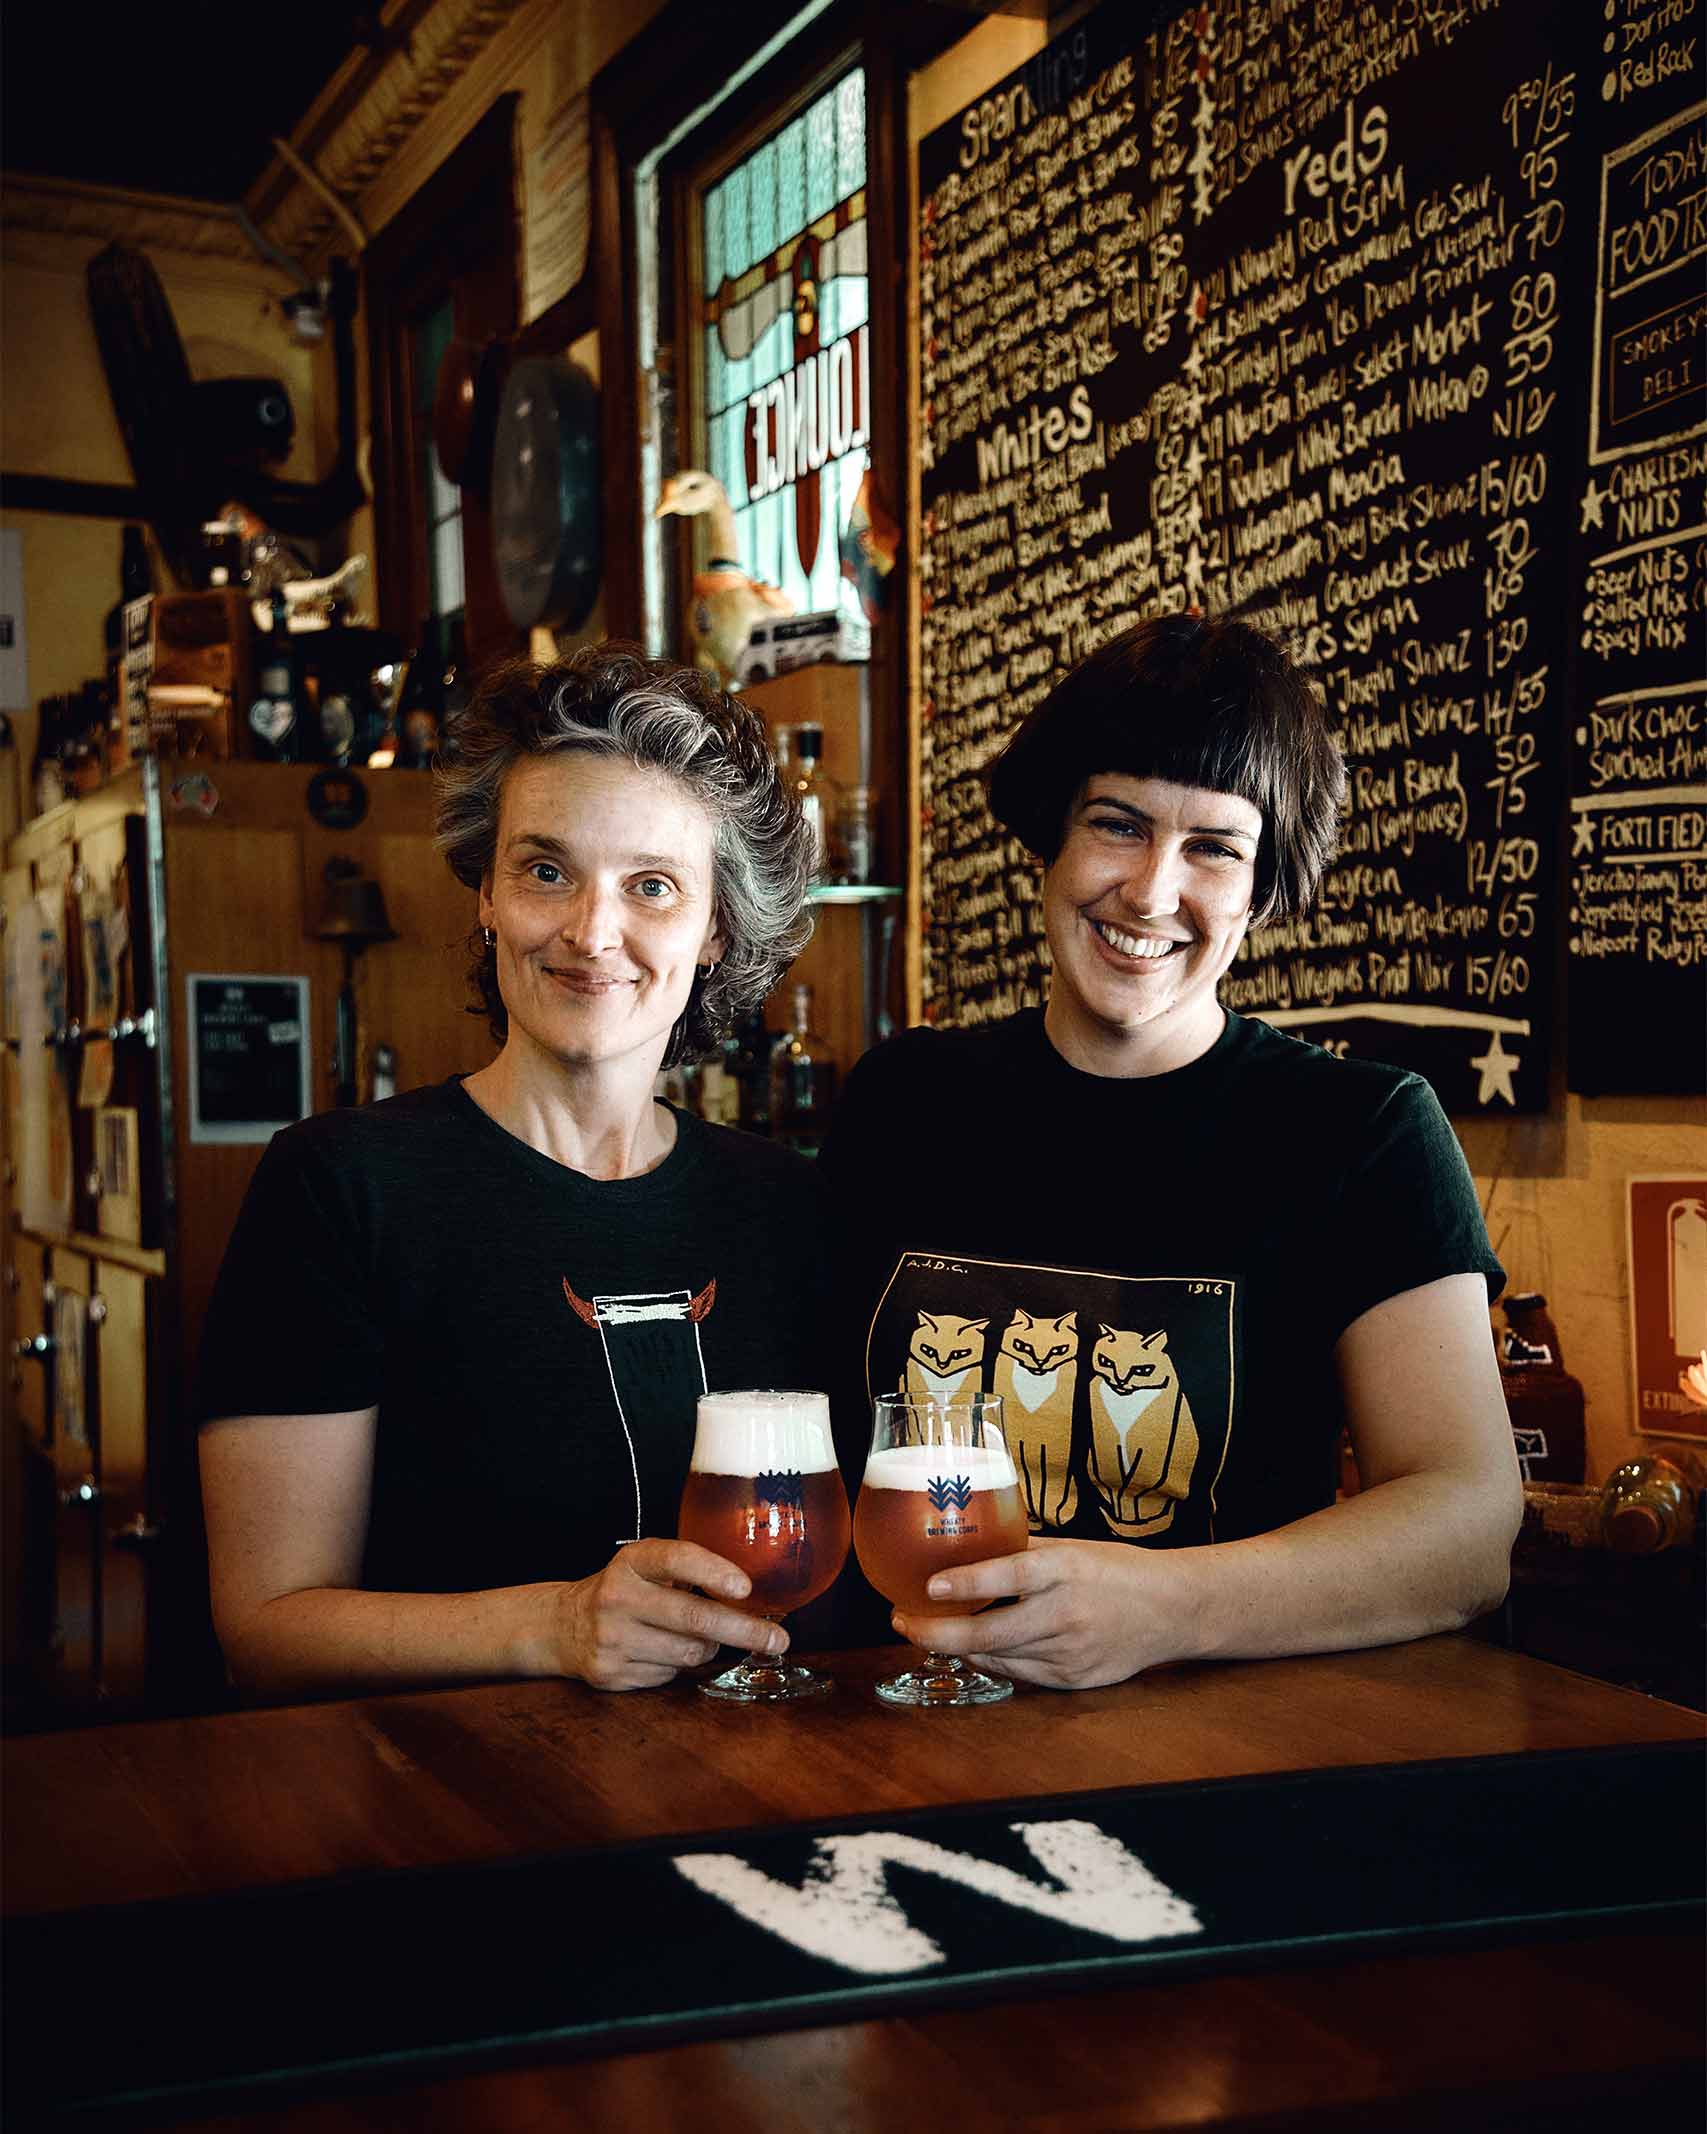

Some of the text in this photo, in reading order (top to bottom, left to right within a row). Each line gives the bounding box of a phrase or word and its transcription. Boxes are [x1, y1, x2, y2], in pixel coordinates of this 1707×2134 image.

[1618, 48, 1655, 103] Red
[1283, 99, 1389, 216] reds
[1520, 132, 1572, 200] 95
[1522, 199, 1567, 262] 70
[1610, 206, 1681, 288] FOOD
[1410, 290, 1495, 369] Merlot
[1509, 271, 1558, 332] 80
[1502, 314, 1561, 389] 55
[1641, 358, 1692, 403] DELI
[1480, 451, 1548, 517] 15/60
[1617, 487, 1682, 542] NUTS
[1484, 517, 1531, 575] 70
[1636, 546, 1690, 590] Nuts
[1343, 592, 1421, 655] Syrah
[1651, 581, 1689, 617] Mix
[1645, 614, 1688, 650] Mix
[1410, 691, 1481, 738] Shiraz
[1590, 700, 1643, 750] Dark
[1355, 765, 1398, 811] Red
[1494, 732, 1536, 773] 50
[1484, 761, 1543, 831] 75
[1465, 836, 1540, 898] 12/50
[1497, 892, 1539, 937] 65
[1465, 949, 1531, 1005] 15/60
[1187, 1282, 1224, 1297] 1916
